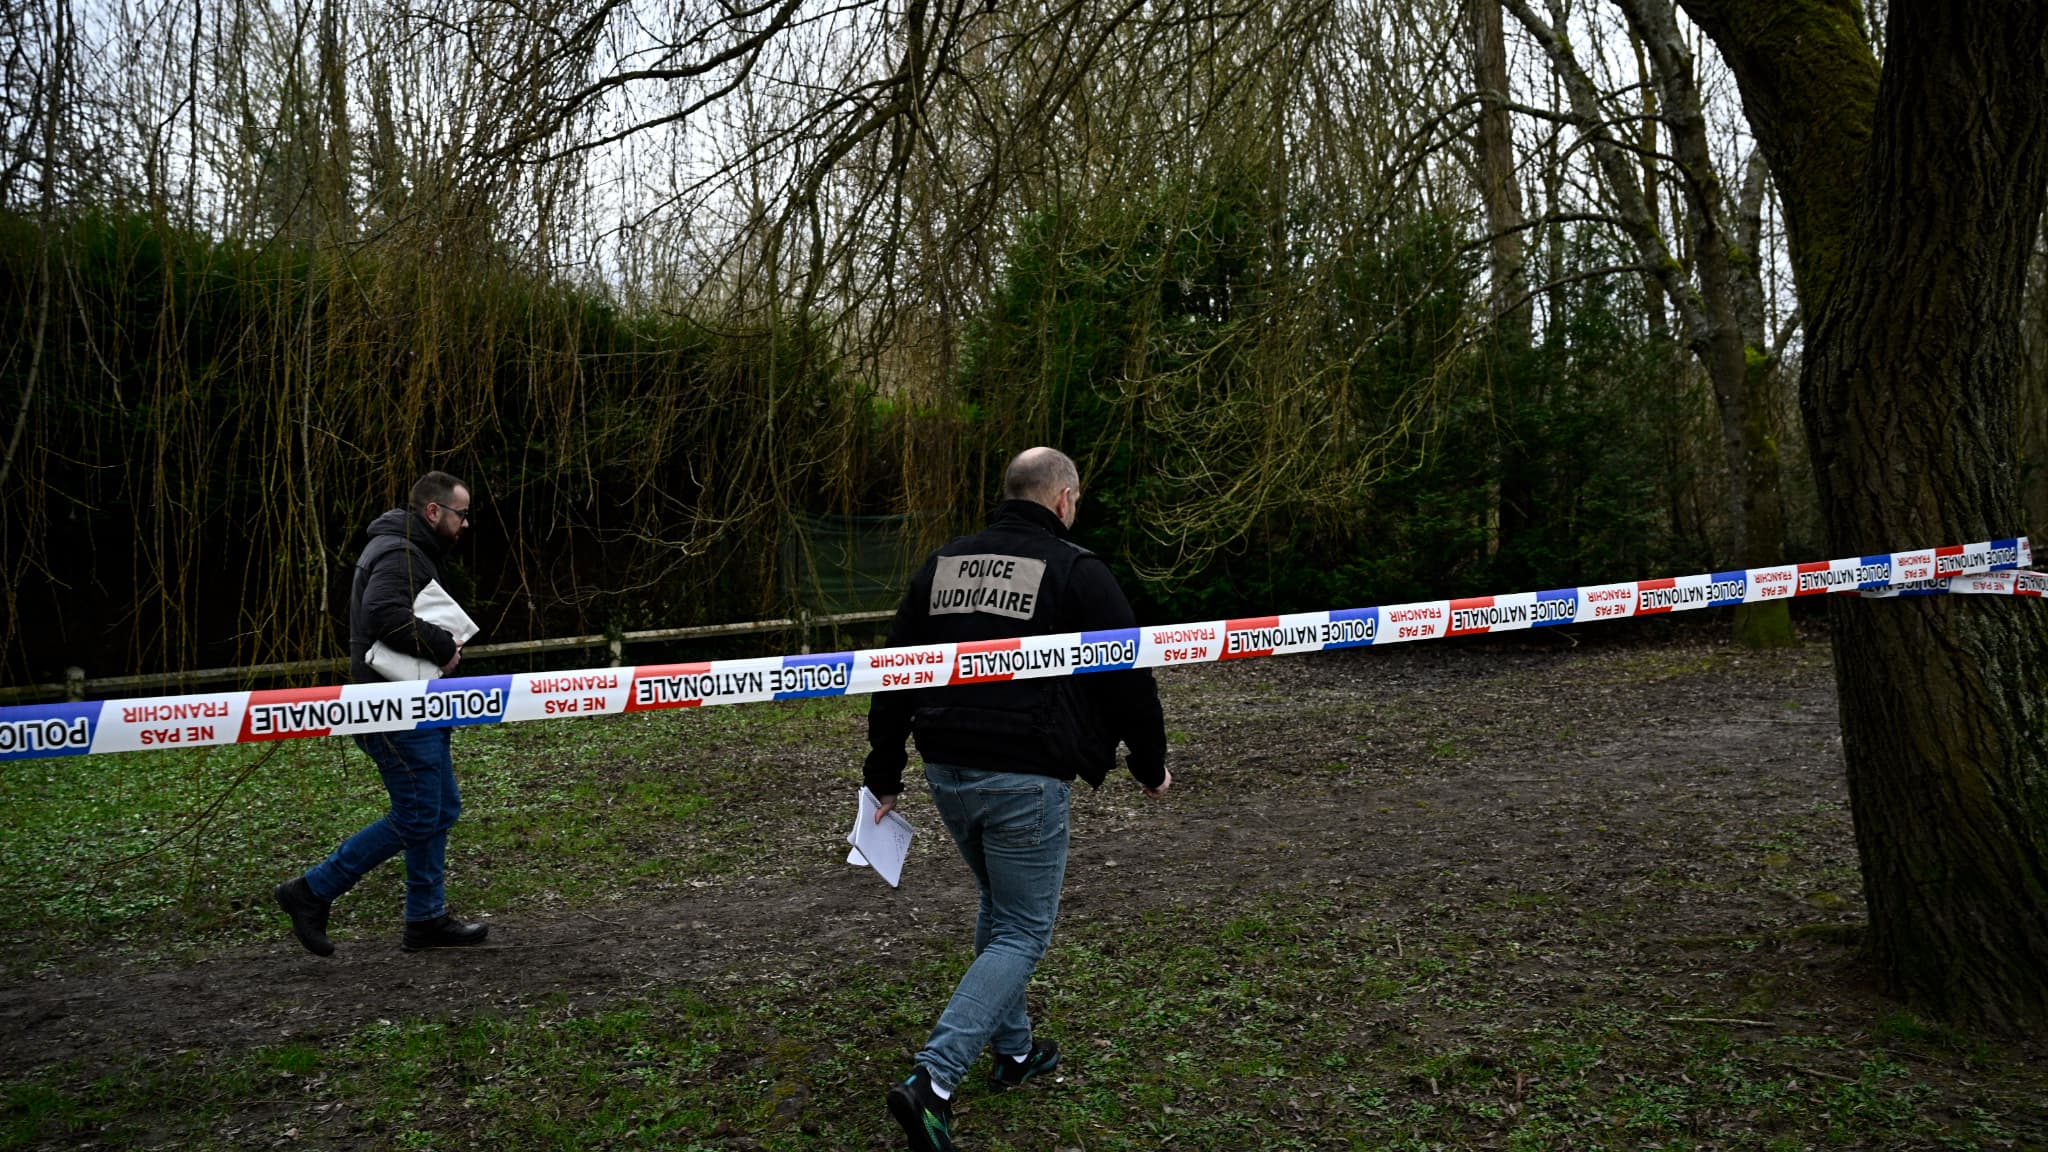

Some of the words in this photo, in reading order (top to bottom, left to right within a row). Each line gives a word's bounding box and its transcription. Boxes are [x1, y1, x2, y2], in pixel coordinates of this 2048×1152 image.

[1938, 552, 1985, 571] NATIONALE
[1986, 549, 2016, 564] POLICE
[958, 559, 1015, 579] POLICE
[1754, 571, 1792, 583] FRANCHIR
[1856, 565, 1889, 581] POLICE
[1904, 569, 1917, 579] PAS
[1918, 568, 1928, 577] NE
[1801, 569, 1854, 589] NATIONALE
[1972, 581, 1993, 590] PAS
[1994, 582, 2005, 591] NE
[1587, 588, 1631, 602] FRANCHIR
[1642, 586, 1703, 607] NATIONALE
[1706, 580, 1744, 599] POLICE
[1762, 586, 1776, 597] PAS
[1777, 585, 1788, 595] NE
[932, 587, 1033, 614] JUDICIAIRE
[1389, 608, 1442, 623] FRANCHIR
[1454, 604, 1526, 629] NATIONALE
[1530, 600, 1574, 621] POLICE
[1595, 605, 1612, 617] PAS
[1613, 604, 1625, 614] NE
[1153, 628, 1215, 645] FRANCHIR
[1231, 625, 1317, 651] NATIONALE
[1321, 620, 1374, 642] POLICE
[1398, 625, 1418, 638] PAS
[1421, 624, 1434, 636] NE
[869, 650, 943, 668] FRANCHIR
[1071, 641, 1133, 666] POLICE
[1164, 648, 1187, 661] PAS
[1191, 646, 1207, 659] NE
[961, 647, 1065, 675] NATIONALE
[530, 674, 618, 694] FRANCHIR
[770, 665, 845, 691] POLICE
[882, 672, 910, 687] PAS
[915, 670, 933, 684] NE
[639, 672, 762, 701] NATIONALE
[411, 691, 500, 719] POLICE
[545, 699, 577, 714] PAS
[583, 696, 606, 711] NE
[122, 701, 228, 723] FRANCHIR
[255, 698, 402, 731] NATIONALE
[0, 720, 87, 750] POLIC
[140, 728, 180, 744] PAS
[187, 725, 214, 741] NE
